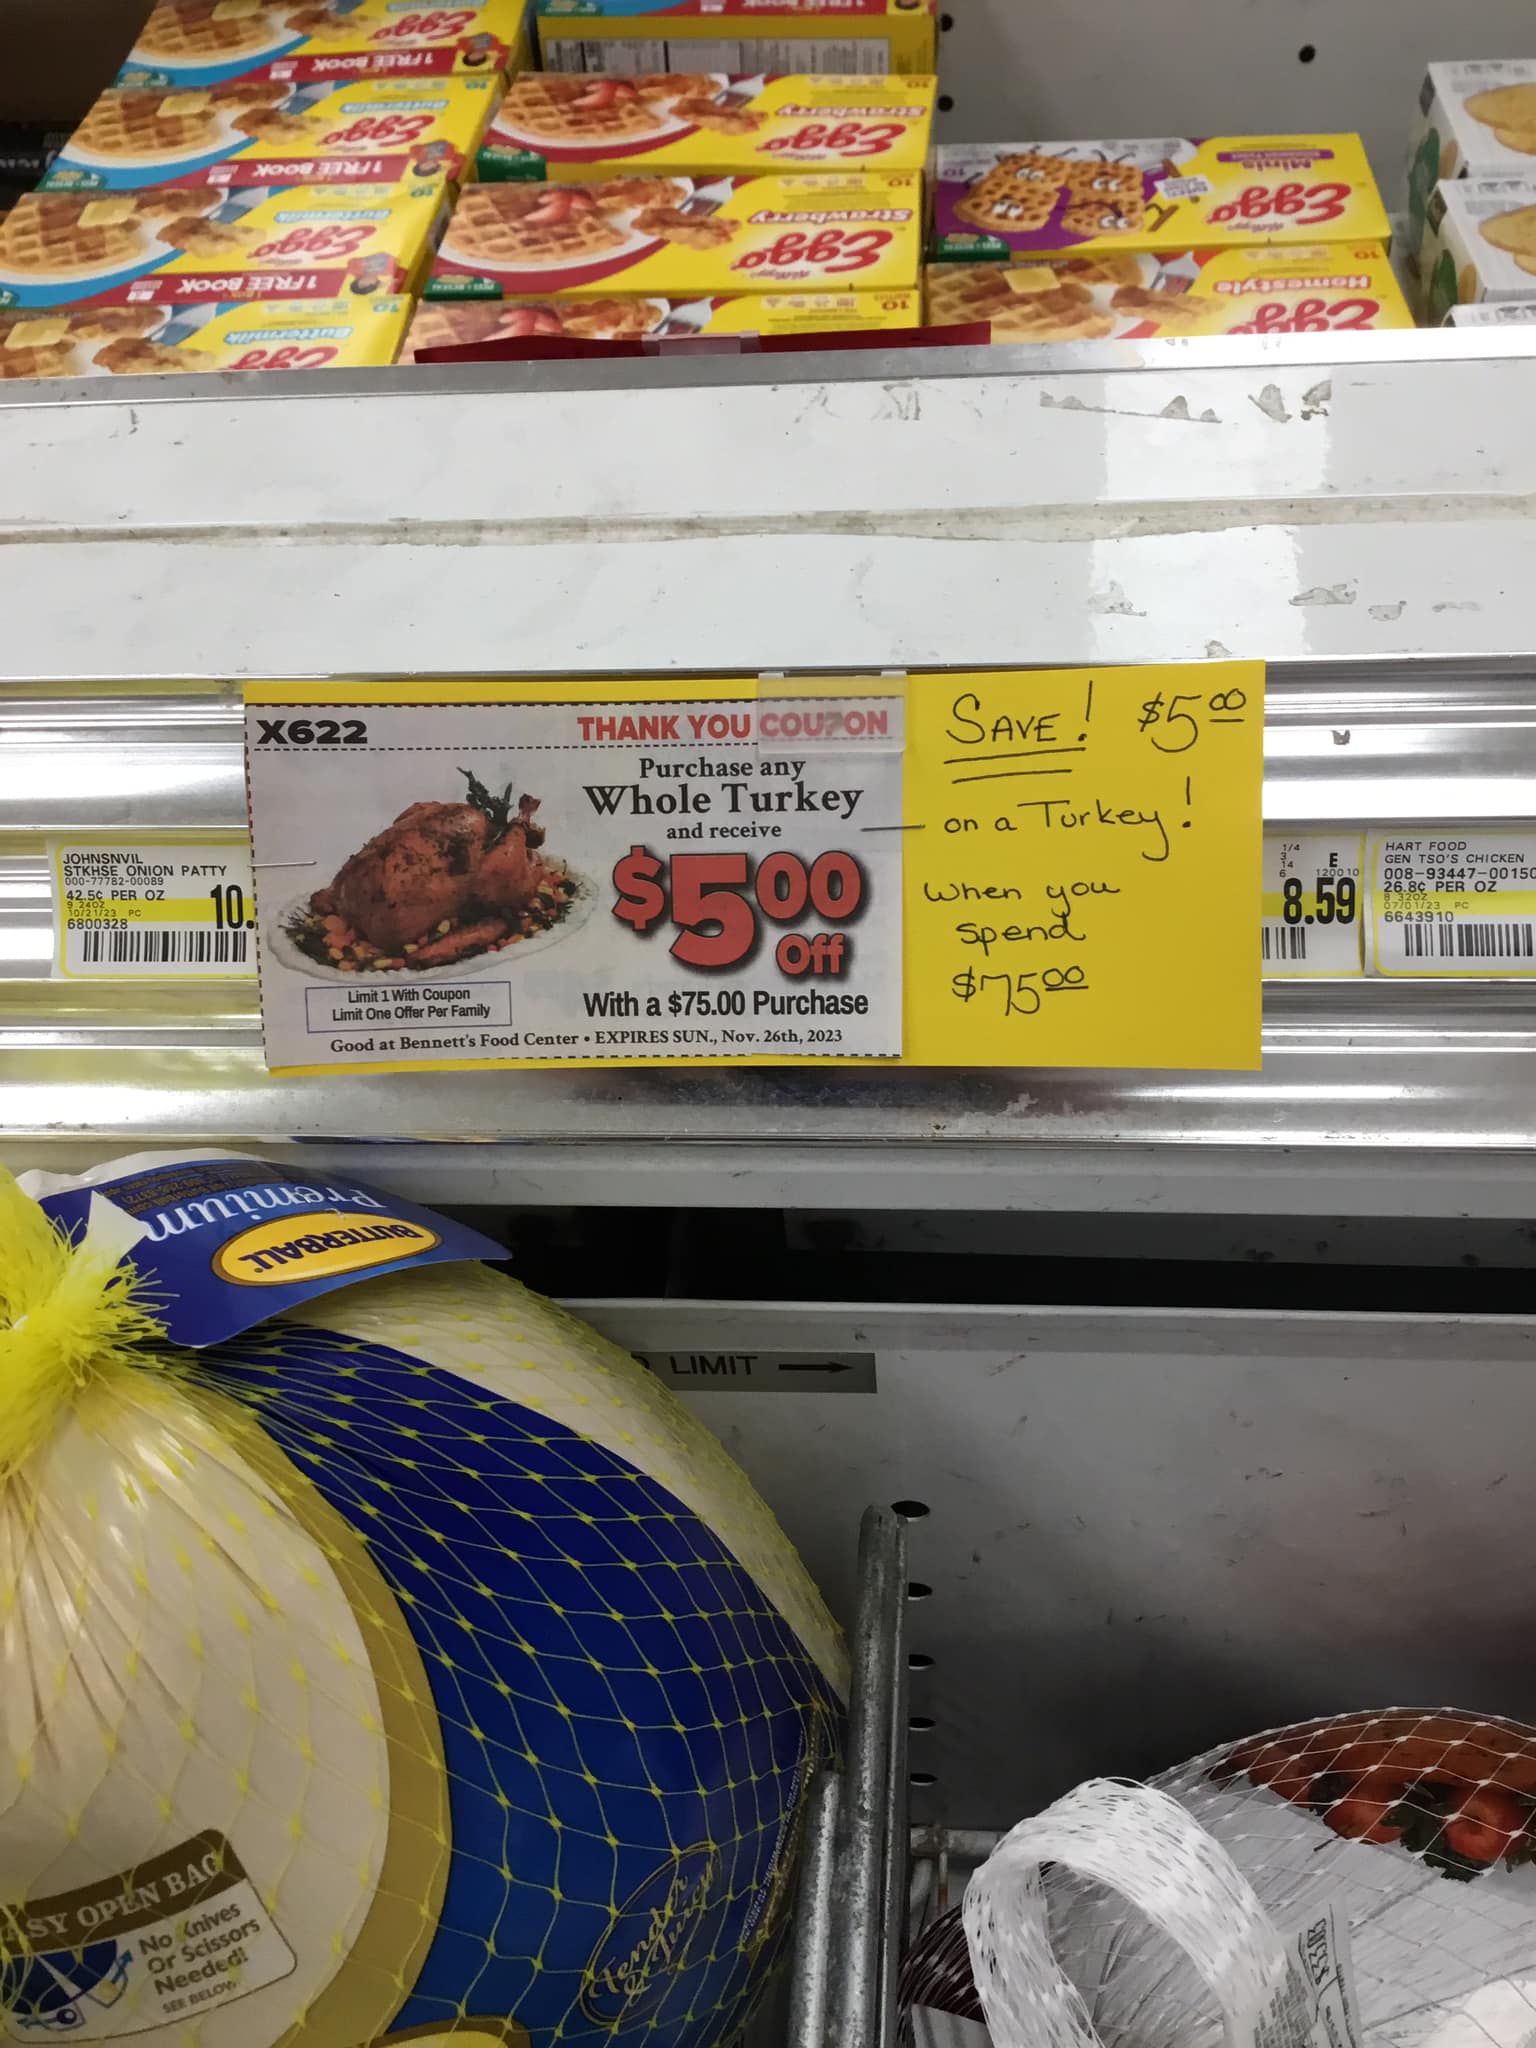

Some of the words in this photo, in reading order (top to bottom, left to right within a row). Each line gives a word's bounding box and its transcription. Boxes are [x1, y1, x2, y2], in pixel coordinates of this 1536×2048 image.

[367, 11, 477, 41] Eggo
[312, 56, 369, 71] BOOK
[374, 53, 422, 68] FREE
[316, 115, 435, 148] Eggo
[755, 123, 907, 157] Eggo
[251, 163, 314, 179] BOOK
[318, 161, 371, 177] FREE
[1205, 183, 1351, 225] Eggo
[748, 208, 913, 225] Strawberry
[246, 226, 377, 260] Eggo
[730, 229, 893, 273] Eggo
[176, 278, 244, 293] BOOK
[249, 276, 305, 291] FREE
[309, 275, 317, 289] 1
[1212, 275, 1371, 295] Homestyle
[882, 301, 910, 311] 10
[223, 327, 353, 344] Buttermilk
[256, 719, 368, 745] X622
[577, 715, 680, 741] THANK
[687, 714, 750, 739] YOU
[759, 711, 888, 736] COUPON
[639, 757, 753, 779] Purchase
[759, 760, 807, 780] any
[583, 785, 713, 815] Whole
[720, 784, 865, 819] Turkey
[666, 823, 704, 840] and
[709, 823, 782, 840] receive
[944, 815, 979, 834] on
[994, 817, 1018, 832] a
[1385, 842, 1421, 851] HART
[1429, 841, 1467, 851] FOOD
[63, 853, 144, 865] JOHNSNVIL
[1329, 852, 1338, 867] E
[1385, 854, 1411, 864] GEN
[1419, 854, 1459, 864] TSO'S
[1465, 853, 1525, 863] CHICKEN
[64, 865, 118, 877] STKHSE
[127, 865, 174, 876] ONION
[181, 865, 228, 876] PATTY
[64, 877, 164, 886] 000-77782-00089
[1435, 881, 1465, 892] PER
[1474, 881, 1497, 893] OZ
[111, 890, 137, 901] PER
[144, 890, 165, 901] OZ
[1045, 881, 1121, 918] you
[1283, 876, 1355, 925] 8.59
[68, 909, 117, 918] 10/21/23
[128, 909, 142, 917] PC
[209, 884, 256, 930] 10.
[1383, 901, 1441, 910] 07/01/23
[1454, 901, 1470, 910] PC
[67, 918, 128, 930] 6800328
[1384, 911, 1454, 922] 6643910
[775, 933, 846, 976] Off
[348, 990, 378, 1003] Limit
[381, 991, 389, 1002] 1
[392, 989, 419, 1002] With
[422, 988, 471, 1004] Coupon
[583, 991, 639, 1017] With
[646, 999, 662, 1016] a
[668, 990, 745, 1018] $75.00
[753, 989, 869, 1016] Purchase
[332, 1007, 363, 1022] Limit
[366, 1007, 392, 1020] One
[396, 1006, 425, 1019] Offer
[428, 1005, 448, 1018] Per
[451, 1003, 491, 1019] Family
[330, 1038, 374, 1052] Good
[379, 1039, 395, 1051] at
[400, 1034, 477, 1050] Bennett's
[480, 1033, 519, 1047] Food
[523, 1031, 579, 1046] Center
[595, 1030, 669, 1044] EXPIRES
[672, 1030, 718, 1046] SUN.,
[722, 1029, 760, 1043] Nov.
[763, 1029, 803, 1045] 26th,
[808, 1029, 843, 1043] 2023
[144, 1185, 387, 1243] Premium
[237, 1223, 423, 1275] BUTTERBALL
[670, 1355, 759, 1375] LIMIT
[76, 1882, 161, 1928] OPEN
[139, 1930, 173, 1955] No
[147, 1953, 177, 1974] Or
[181, 1919, 260, 1963] Scissors
[154, 1947, 248, 1995] Needed!
